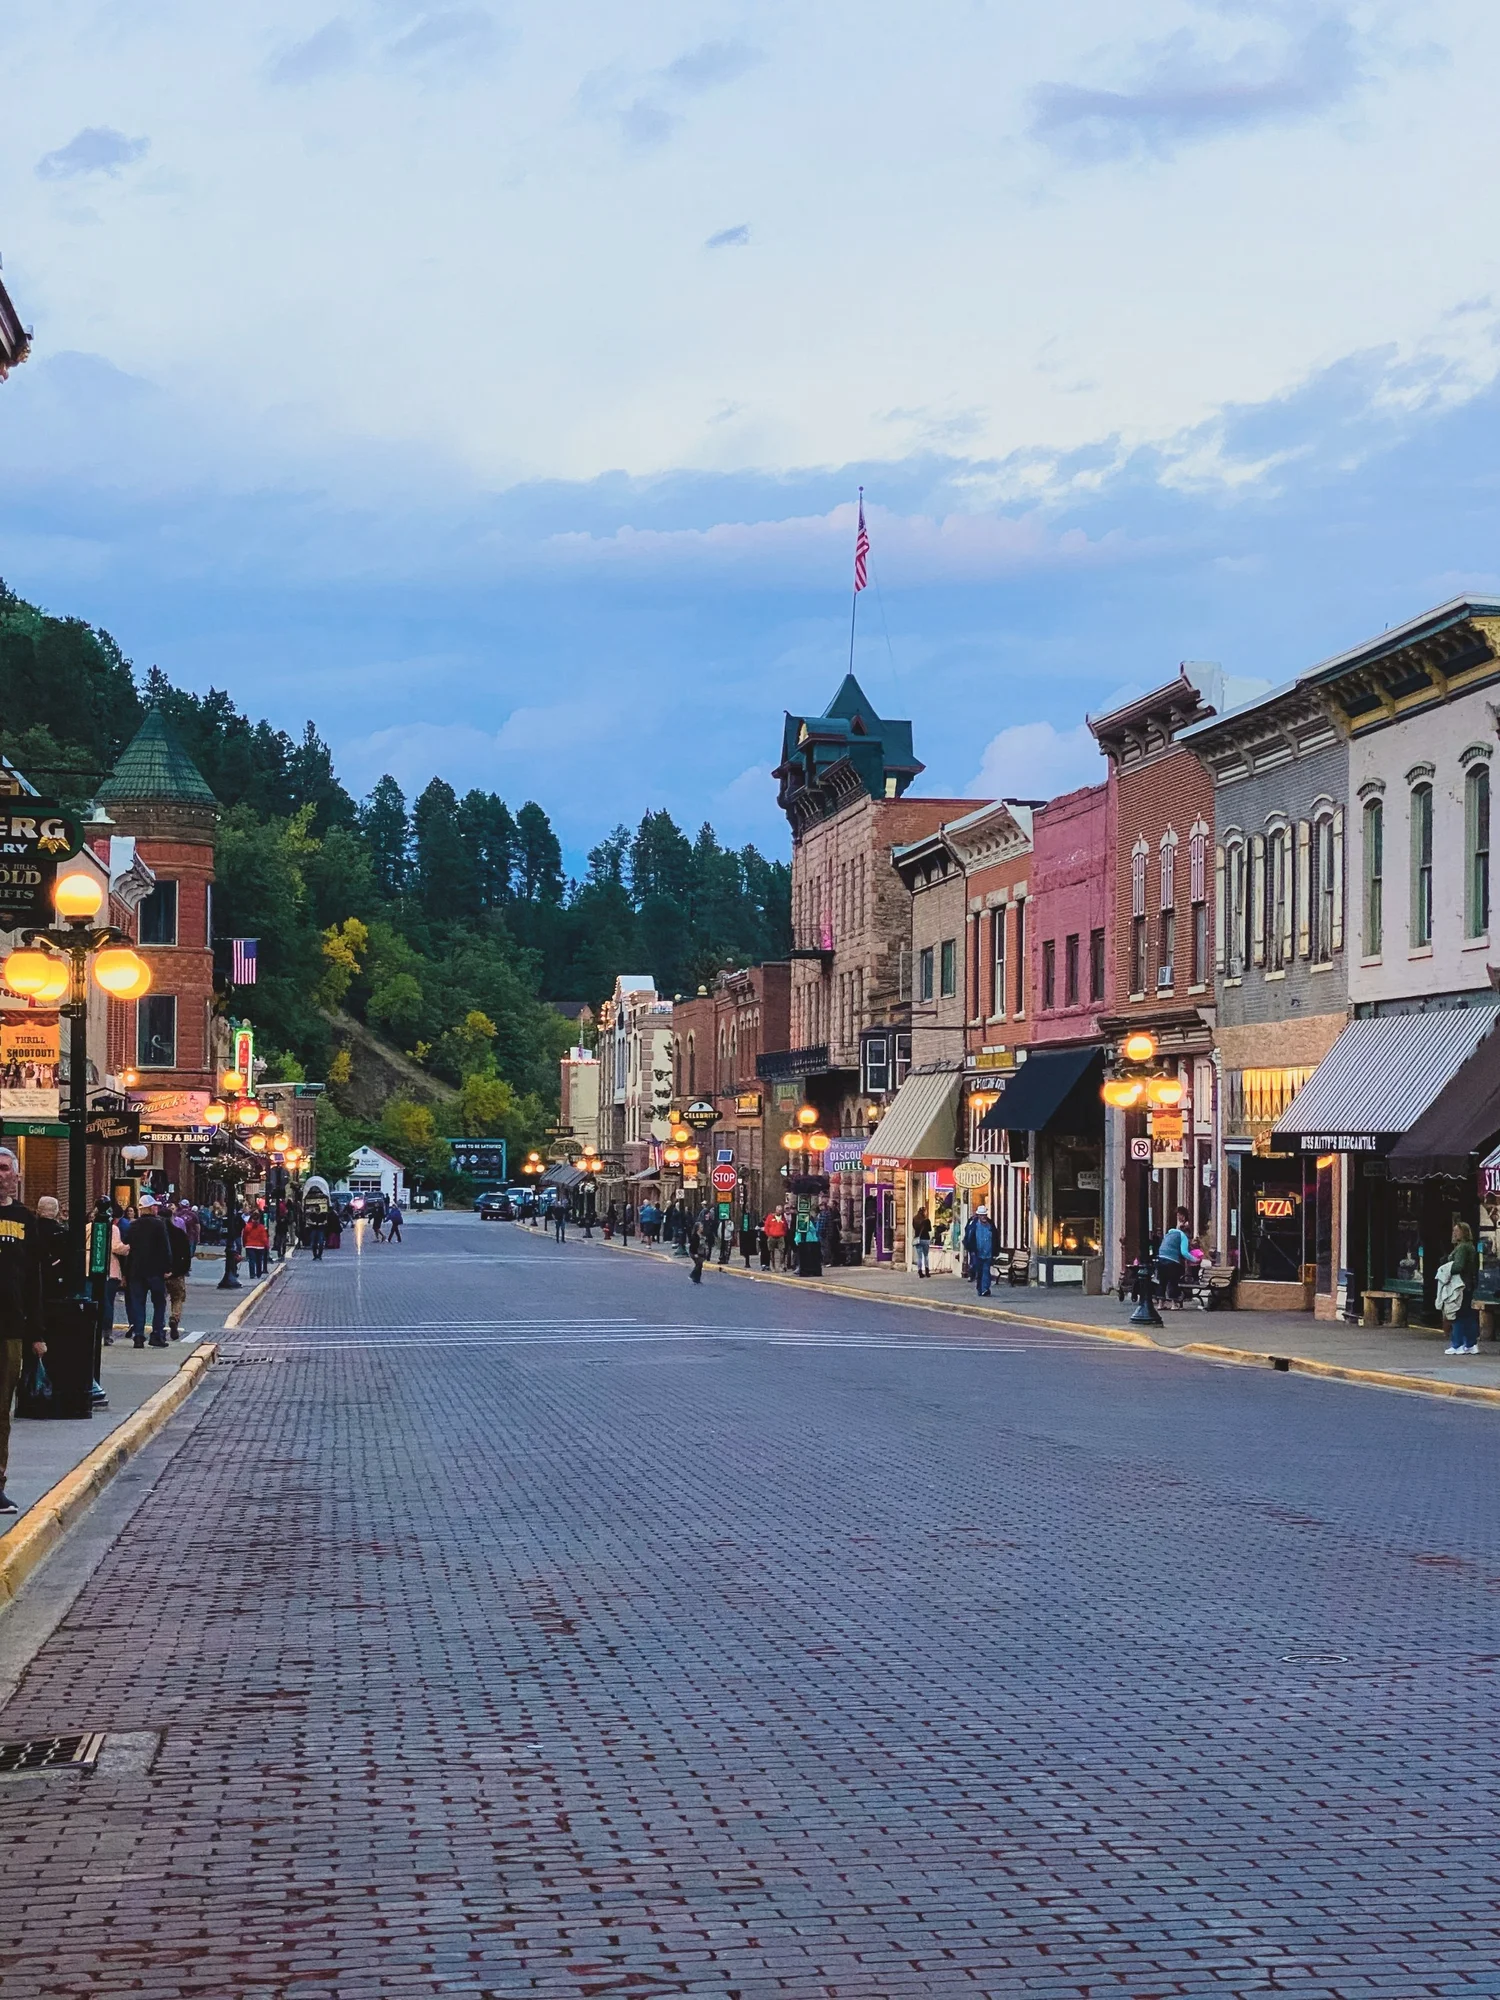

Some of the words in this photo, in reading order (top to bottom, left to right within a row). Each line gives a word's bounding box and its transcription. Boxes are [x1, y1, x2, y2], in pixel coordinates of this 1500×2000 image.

[0, 843, 28, 854] RY
[15, 1036, 46, 1044] THRILL
[6, 1048, 55, 1058] SHOOTOUT!
[131, 1097, 188, 1116] Peacock's
[683, 1112, 719, 1120] CELEBRITY
[28, 1124, 46, 1135] Gold
[151, 1133, 173, 1142] BEER
[174, 1133, 182, 1142] &
[183, 1133, 210, 1142] BLING
[1300, 1136, 1314, 1150] MISS
[1314, 1136, 1337, 1150] KITTY'S
[1338, 1135, 1376, 1150] MERCANTILE
[829, 1150, 864, 1162] DISCOU
[714, 1172, 736, 1183] STOP
[1257, 1200, 1293, 1217] PIZZA
[96, 1223, 104, 1266] TROLLEY
